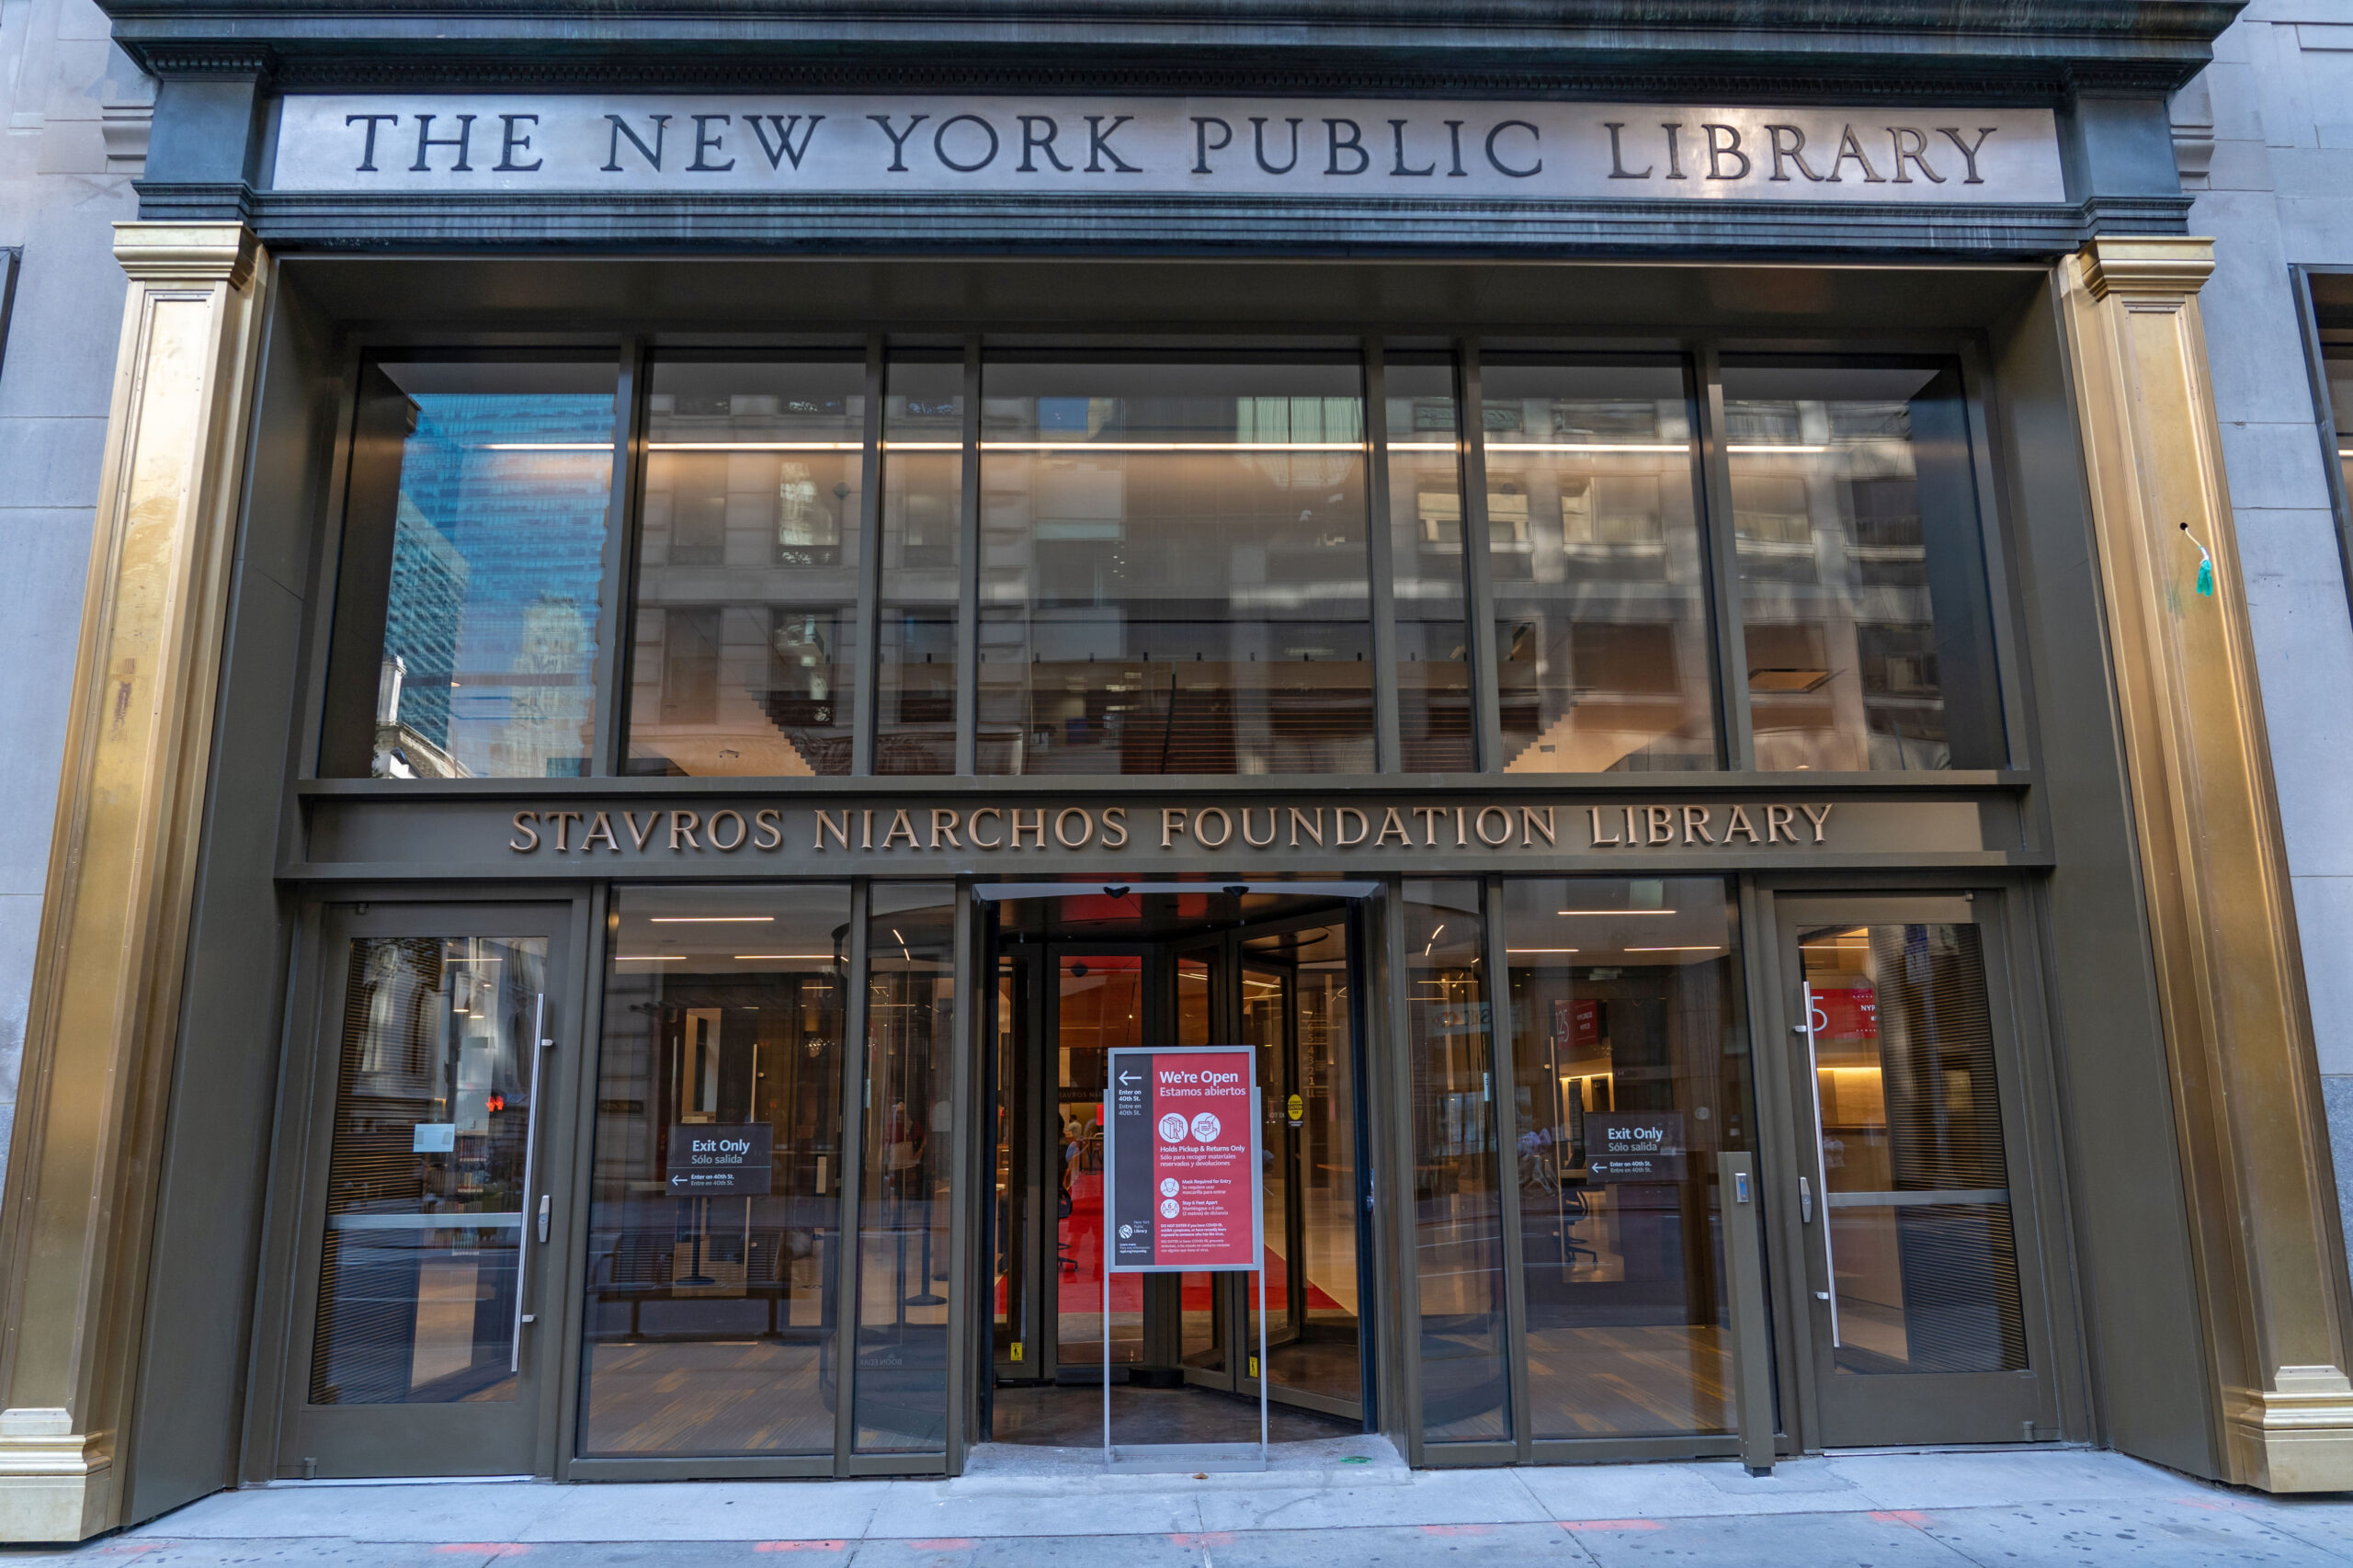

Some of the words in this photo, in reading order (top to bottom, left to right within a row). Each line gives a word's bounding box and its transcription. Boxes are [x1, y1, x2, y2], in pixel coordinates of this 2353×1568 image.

[345, 113, 544, 172] THE
[600, 113, 826, 173] NEW
[865, 113, 1143, 173] YORK
[1191, 115, 1542, 177] PUBLIC
[1603, 121, 1998, 184] LIBRARY
[509, 808, 782, 853] STAVROS
[813, 806, 1131, 850] NIARCHOS
[1158, 803, 1557, 848] FOUNDATION
[1588, 801, 1835, 847] LIBRARY
[1159, 1071, 1198, 1084] We're
[1200, 1070, 1239, 1086] Open
[1159, 1086, 1202, 1096] Estamos
[1204, 1085, 1246, 1096] abiertos
[1608, 1127, 1631, 1140] Exit
[1633, 1126, 1663, 1142] Only
[692, 1140, 716, 1152] Exit
[719, 1139, 750, 1154] Only
[1608, 1142, 1629, 1152] Sólo
[1631, 1142, 1657, 1152] salida
[691, 1153, 712, 1165] Sólo
[715, 1154, 743, 1164] salida
